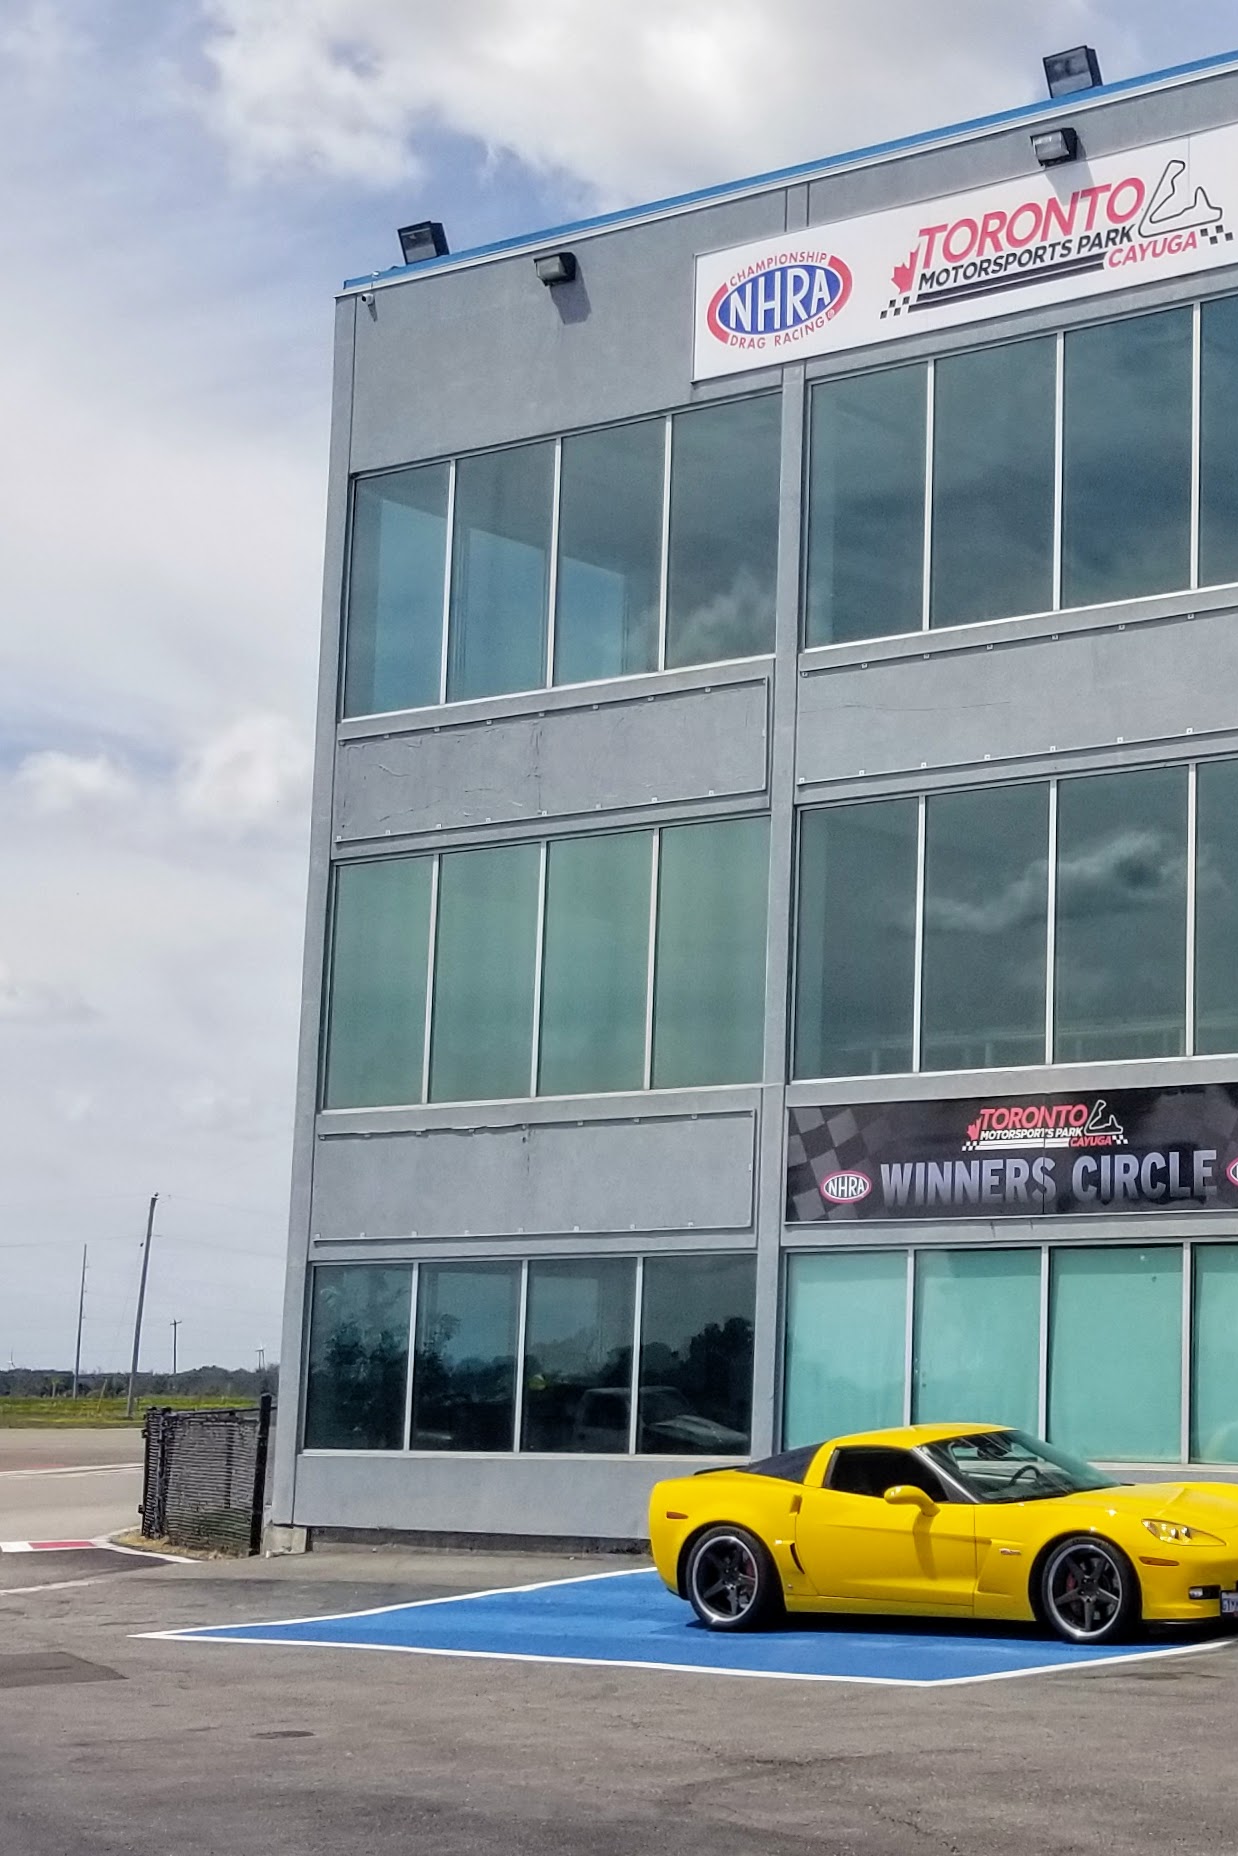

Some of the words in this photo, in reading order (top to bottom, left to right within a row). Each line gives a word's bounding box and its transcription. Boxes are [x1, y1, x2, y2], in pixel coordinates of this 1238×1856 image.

[917, 177, 1146, 269] TORONTO
[918, 239, 1073, 291] MOTORSPORTS
[1077, 224, 1136, 255] PARK
[1107, 231, 1198, 269] CAYUGA
[729, 251, 828, 287] CHAMPIONSHIP
[729, 267, 831, 332] NHRA
[730, 335, 766, 349] DRAG
[774, 316, 825, 347] RACING
[980, 1104, 1088, 1130] TORONTO
[980, 1127, 1055, 1140] MOTORSPORTS
[1055, 1126, 1084, 1138] PARK
[1070, 1136, 1112, 1147] CAYUGA
[827, 1176, 866, 1198] NHRA
[880, 1157, 1056, 1207] WINNERS
[1071, 1150, 1217, 1201] CIRCLE
